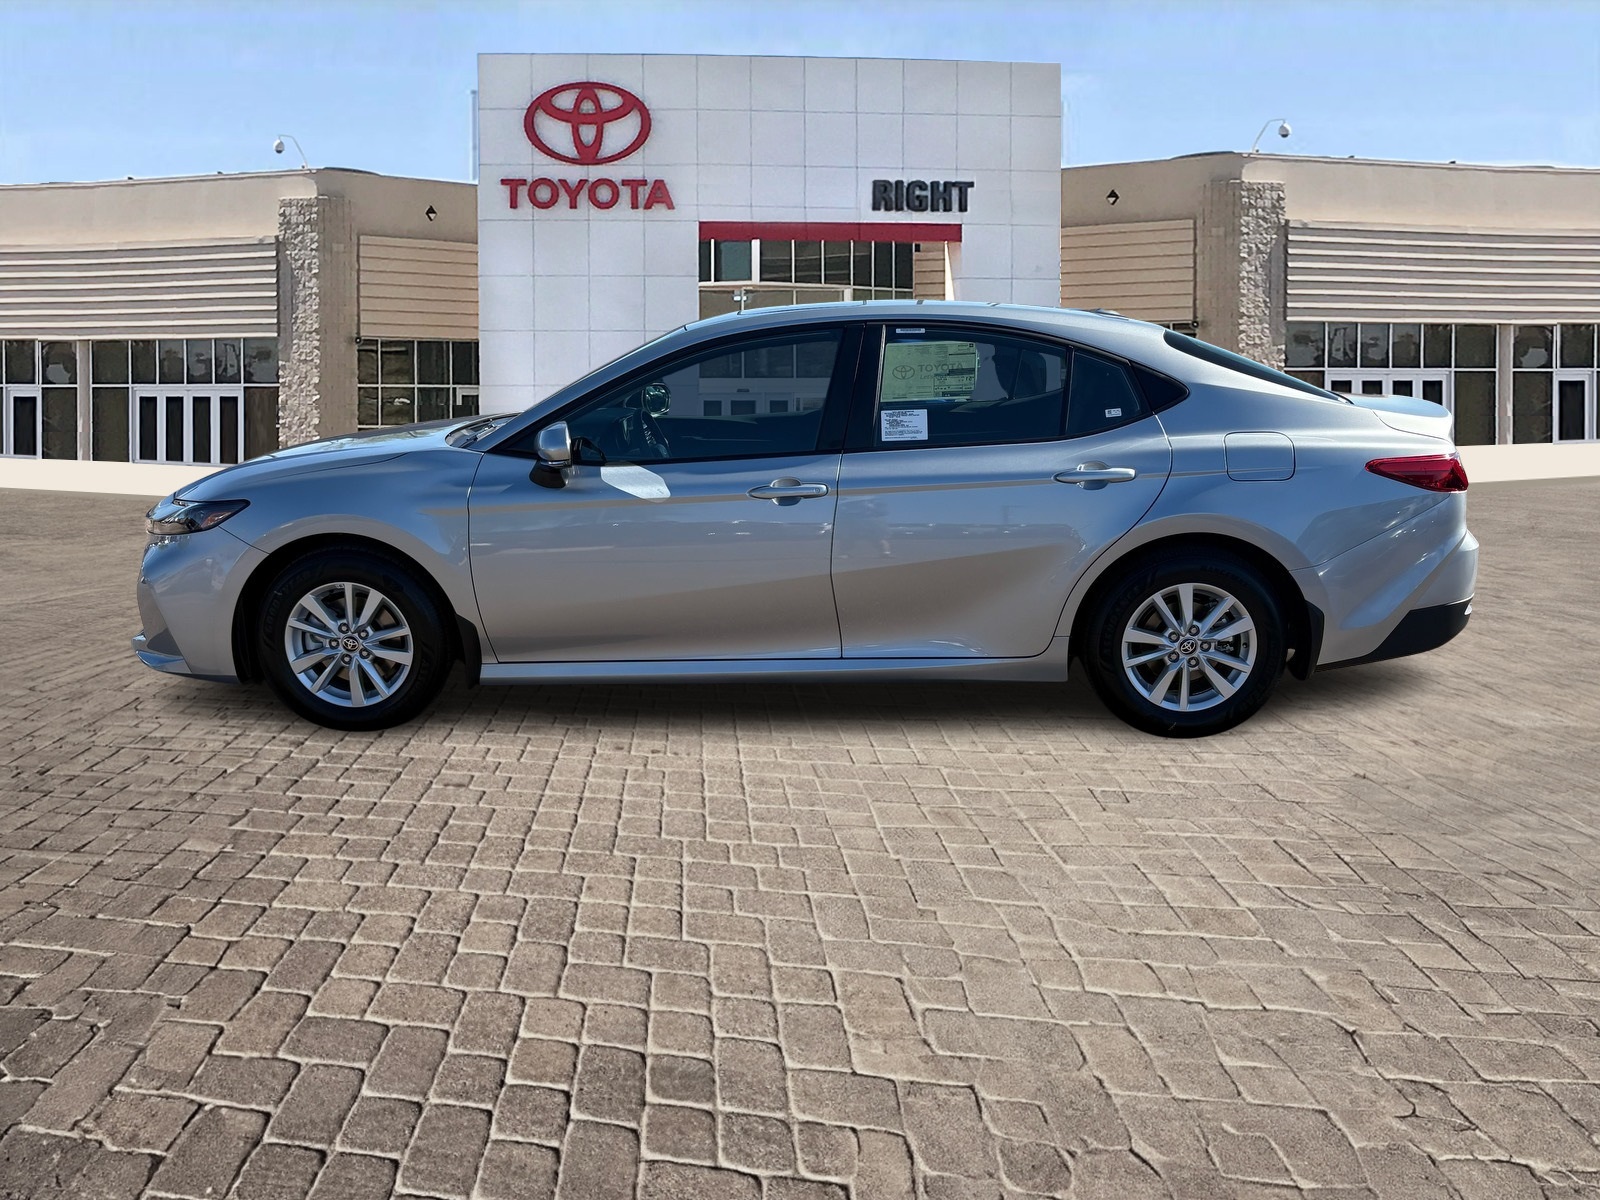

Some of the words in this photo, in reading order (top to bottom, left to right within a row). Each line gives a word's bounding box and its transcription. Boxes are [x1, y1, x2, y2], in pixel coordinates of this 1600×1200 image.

[500, 178, 675, 210] TOYOTA
[872, 179, 975, 213] RIGHT
[918, 363, 963, 373] TOYOTA
